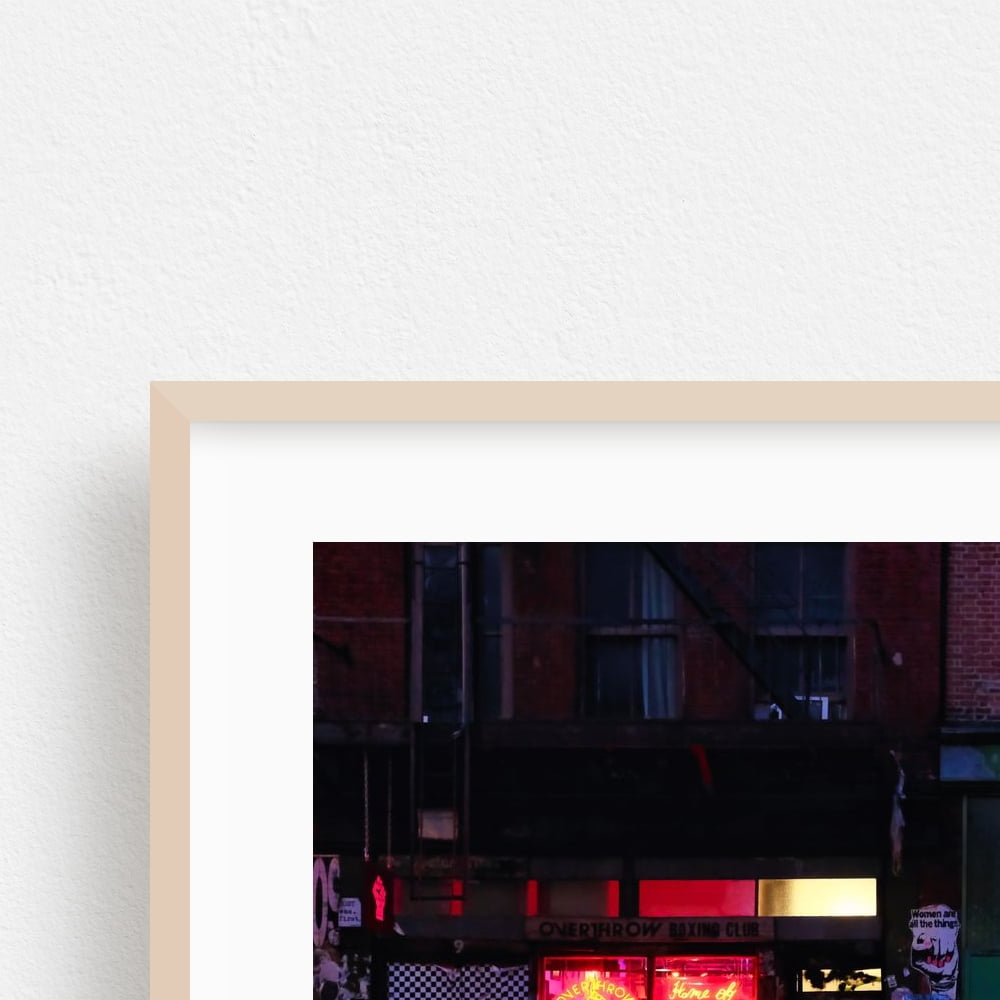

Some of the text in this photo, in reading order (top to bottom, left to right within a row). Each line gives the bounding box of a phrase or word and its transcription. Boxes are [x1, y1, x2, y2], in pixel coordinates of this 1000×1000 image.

[912, 909, 942, 918] Women
[539, 921, 759, 938] OVERTHROW BOXING CLUB
[920, 919, 933, 928] the
[454, 939, 464, 954] 9
[668, 980, 711, 1000] Home
